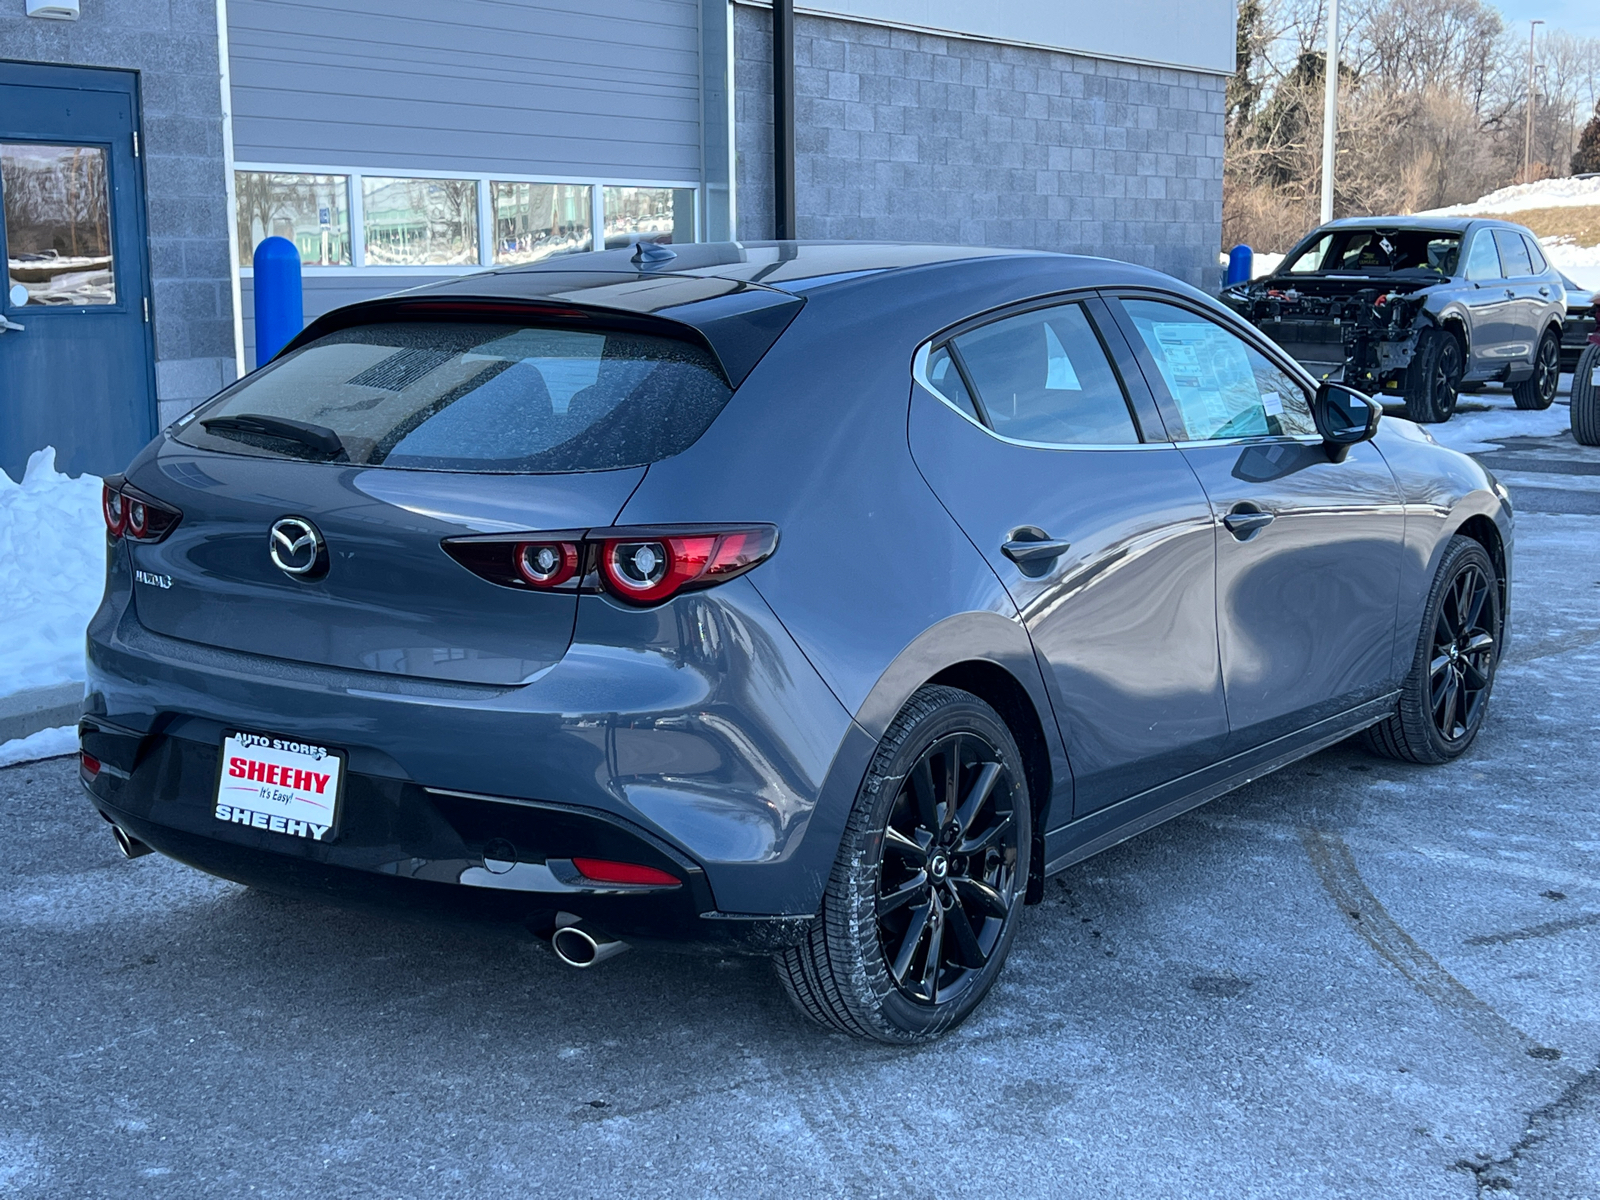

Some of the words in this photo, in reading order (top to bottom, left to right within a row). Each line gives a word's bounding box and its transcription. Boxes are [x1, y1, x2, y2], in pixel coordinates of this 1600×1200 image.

[235, 732, 269, 747] AUTO
[273, 739, 327, 757] STORES
[229, 757, 330, 794] SHEEHY
[259, 786, 271, 799] It's
[272, 792, 294, 806] Easy!
[215, 804, 329, 841] SHEEHY
